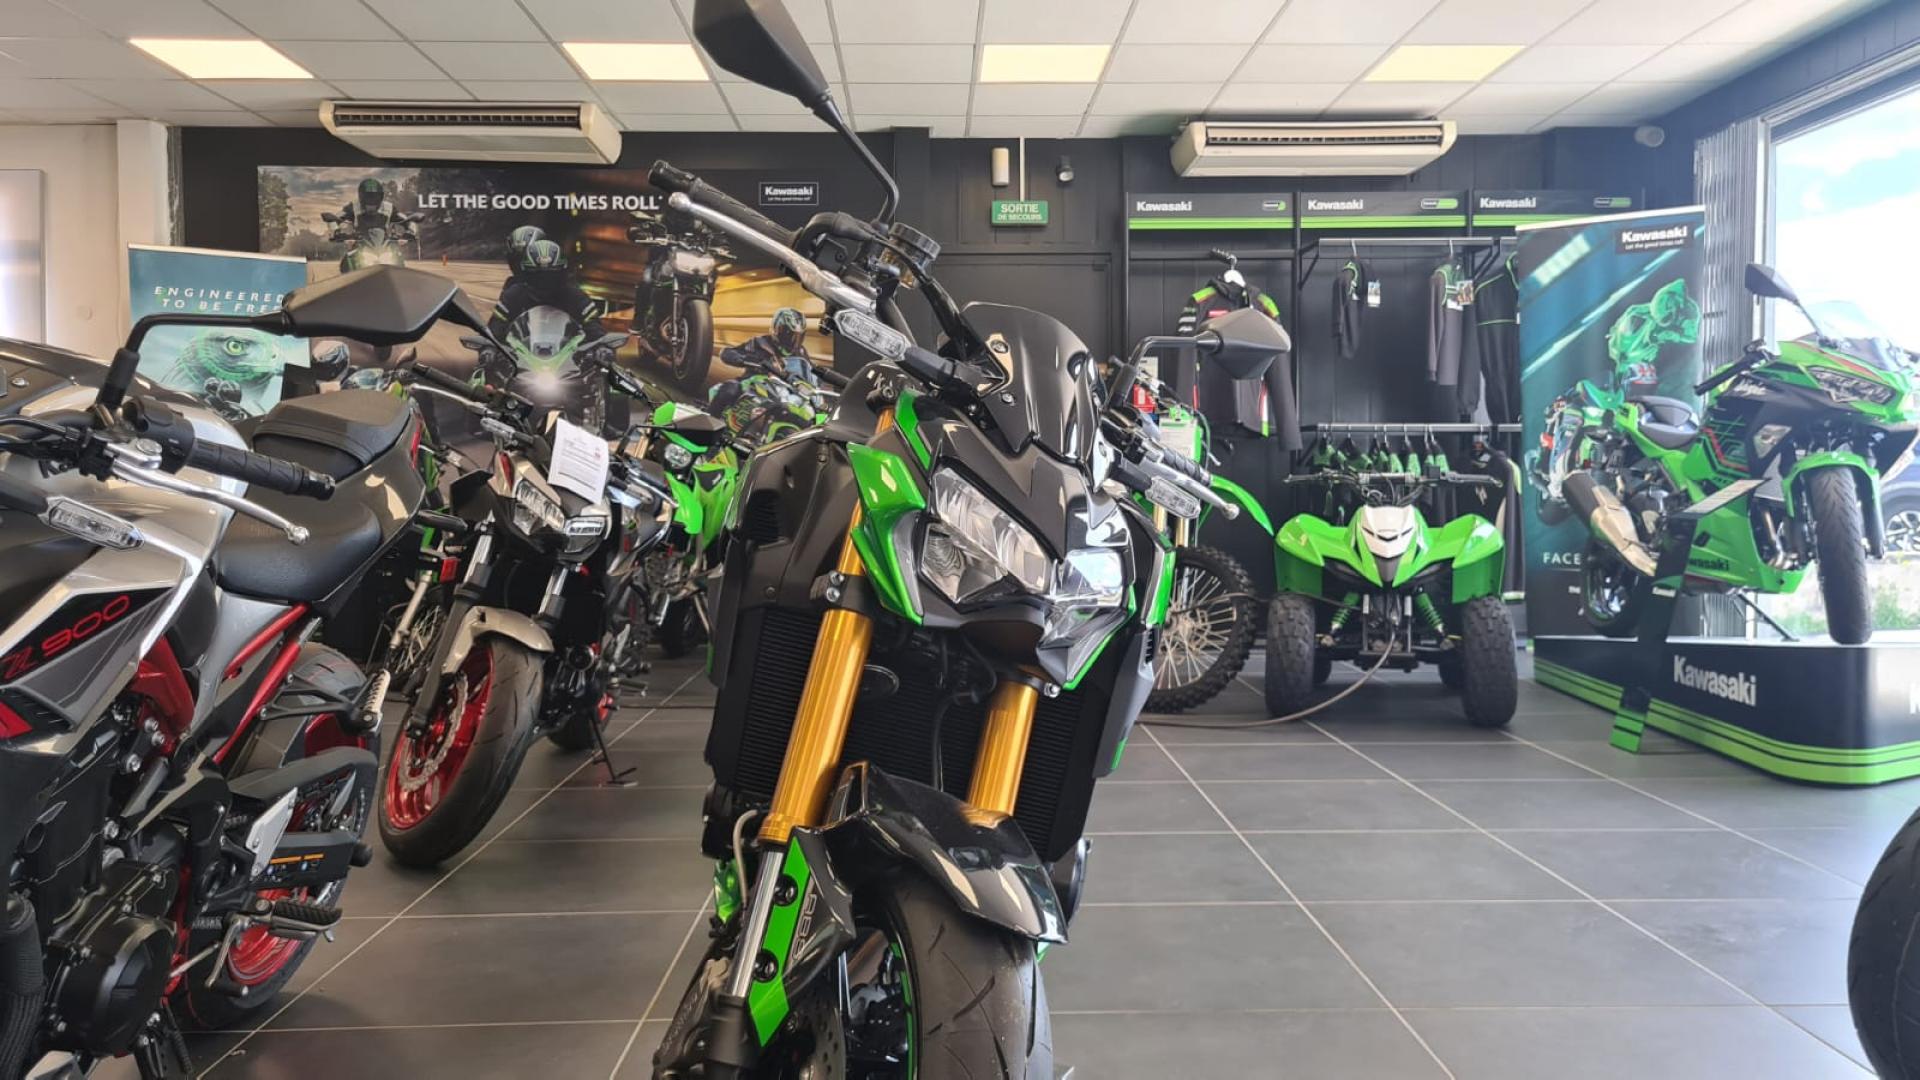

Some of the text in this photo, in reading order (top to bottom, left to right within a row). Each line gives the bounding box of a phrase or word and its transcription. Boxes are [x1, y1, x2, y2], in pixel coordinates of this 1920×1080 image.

[765, 186, 813, 196] Kawasaki
[418, 194, 660, 211] LET THE GOOD TIMES ROLL
[1001, 203, 1039, 213] SORTIE
[1136, 201, 1193, 212] Kawasaki
[1307, 199, 1364, 210] Kawasaki
[1480, 197, 1537, 208] Kawasaki
[1622, 226, 1687, 243] Kawasaki
[162, 298, 185, 309] TO
[199, 301, 223, 311] BE
[1543, 552, 1582, 565] FACE
[1673, 654, 1757, 707] Kawasaki
